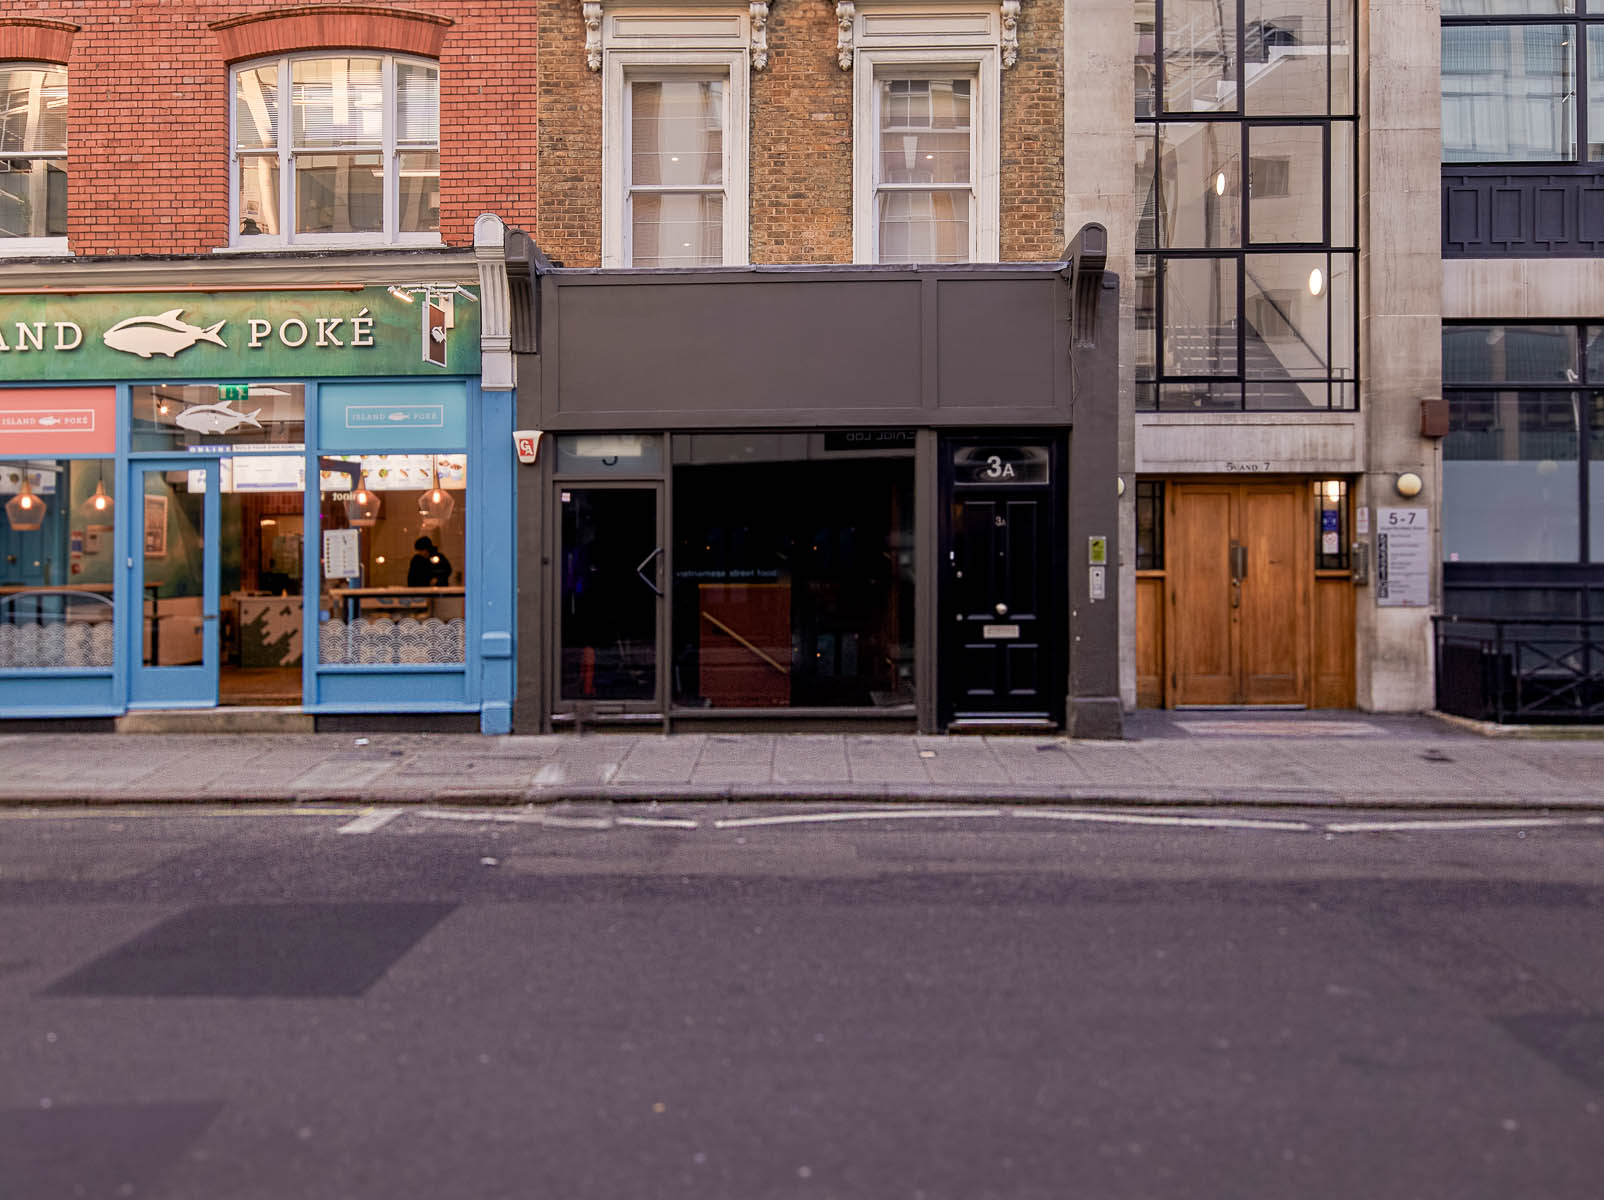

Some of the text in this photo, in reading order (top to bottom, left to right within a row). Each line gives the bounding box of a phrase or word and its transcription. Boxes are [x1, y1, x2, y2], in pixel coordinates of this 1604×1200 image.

[247, 307, 374, 347] POKÉ
[2, 416, 37, 425] ISLAND
[986, 456, 1015, 478] 3A
